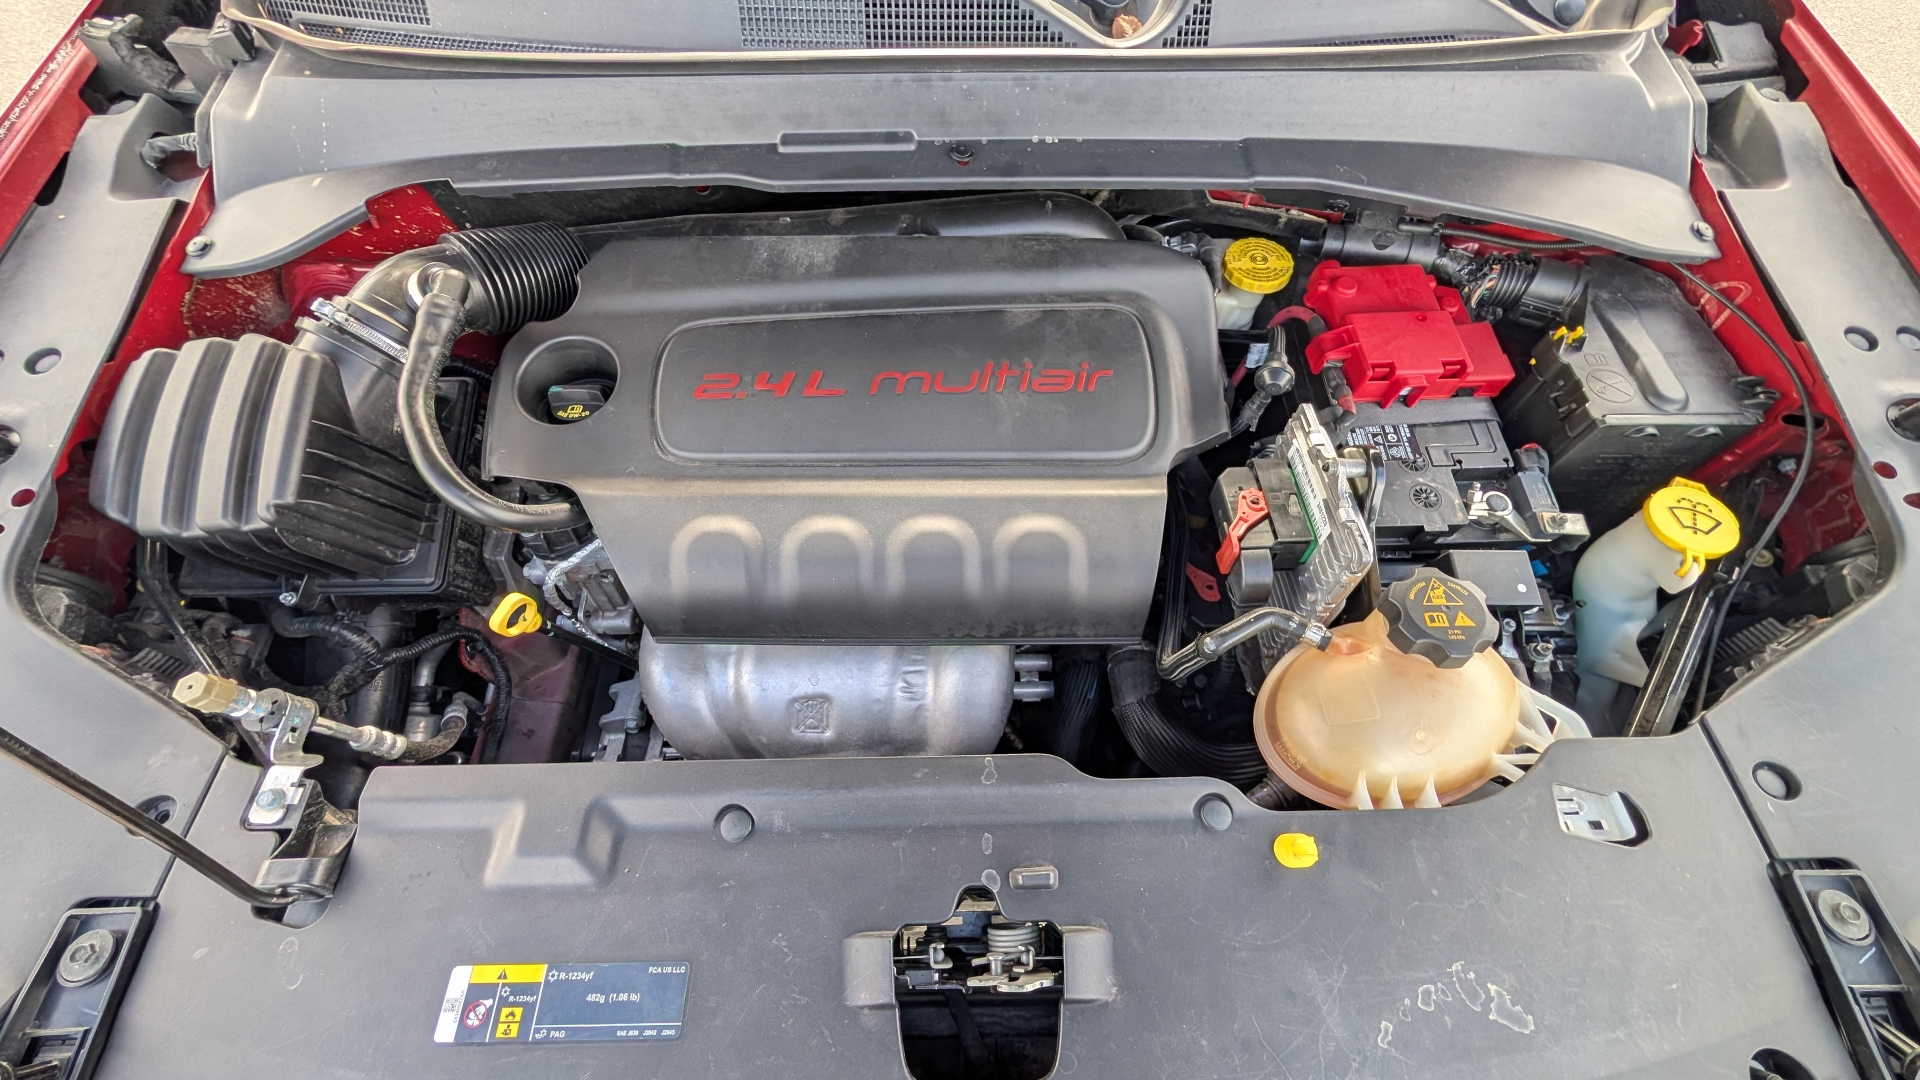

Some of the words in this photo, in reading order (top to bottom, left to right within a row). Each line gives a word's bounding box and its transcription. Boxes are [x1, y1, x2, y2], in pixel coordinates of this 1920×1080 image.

[870, 362, 1113, 394] multiair
[559, 971, 594, 982] R-1234yf
[508, 995, 537, 1003] R-1234yf
[586, 994, 606, 1004] 482g
[608, 993, 628, 1003] (1.06
[629, 992, 641, 1003] lb)
[549, 1030, 566, 1039] PAG
